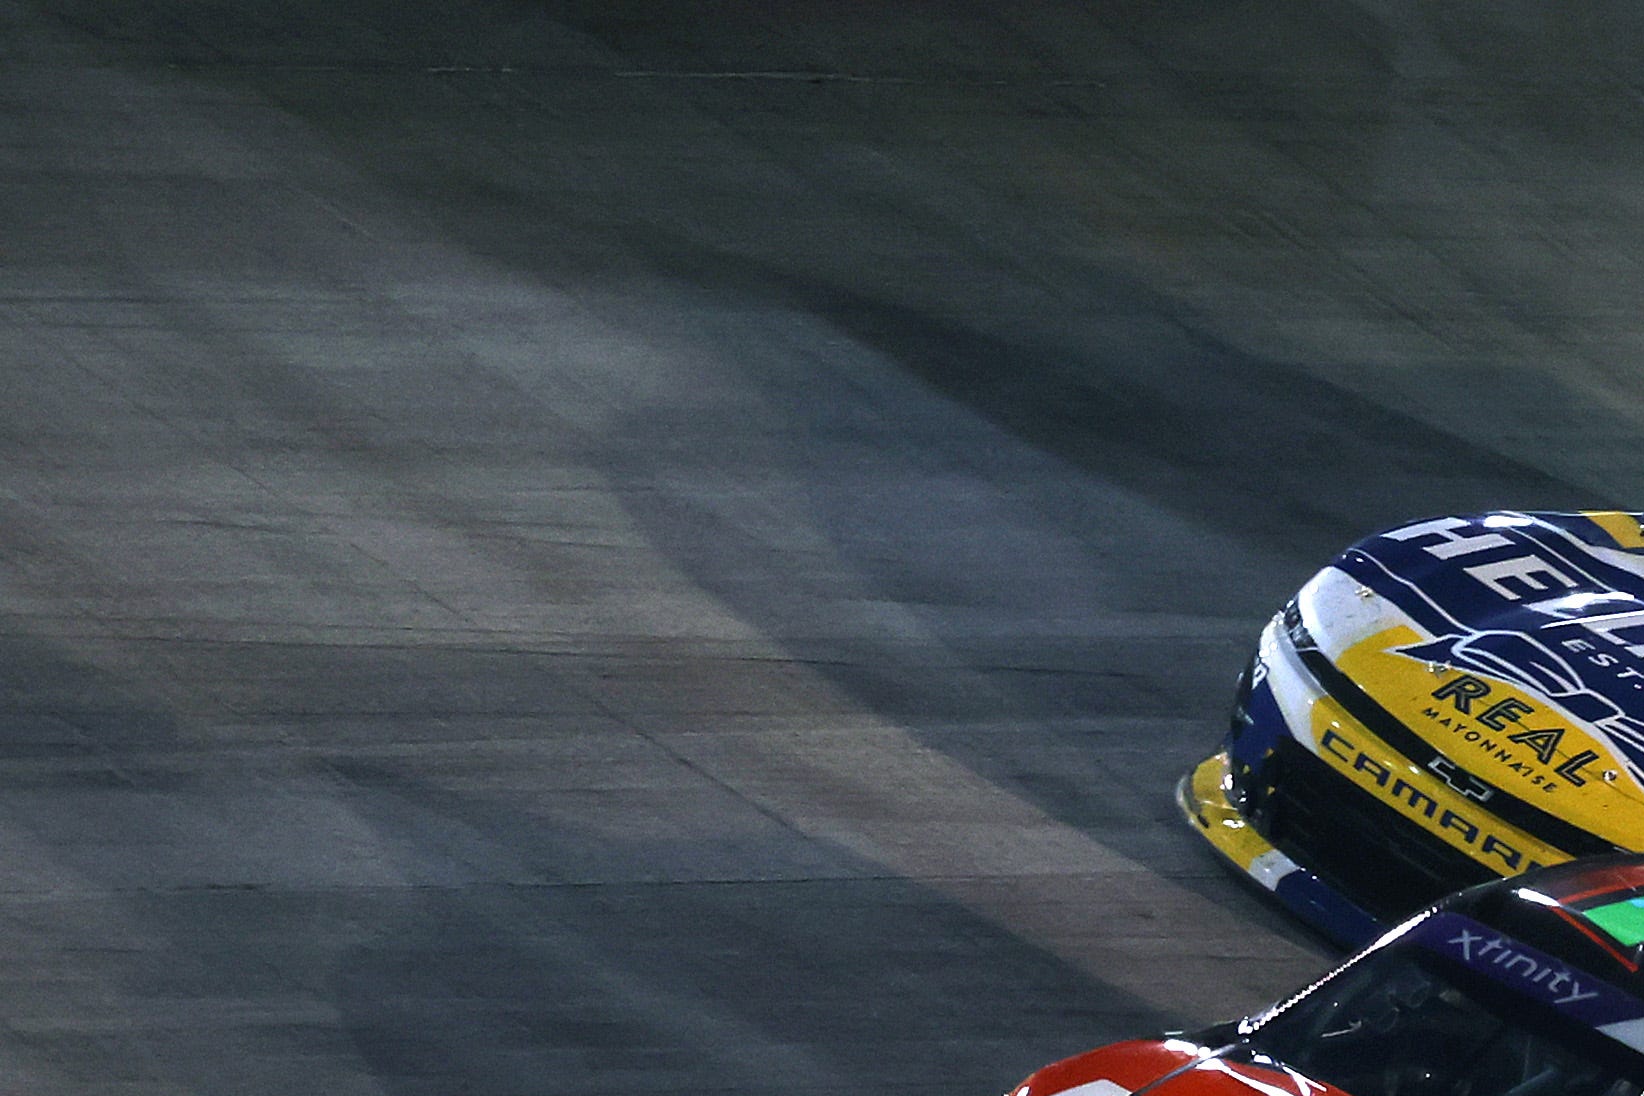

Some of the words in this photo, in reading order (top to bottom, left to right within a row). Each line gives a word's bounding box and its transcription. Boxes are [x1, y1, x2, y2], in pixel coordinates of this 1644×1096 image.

[1422, 707, 1558, 793] MAYONNAISE
[1432, 674, 1599, 787] REAL
[1320, 728, 1544, 871] CAMAR
[1448, 929, 1599, 1004] xfinity
